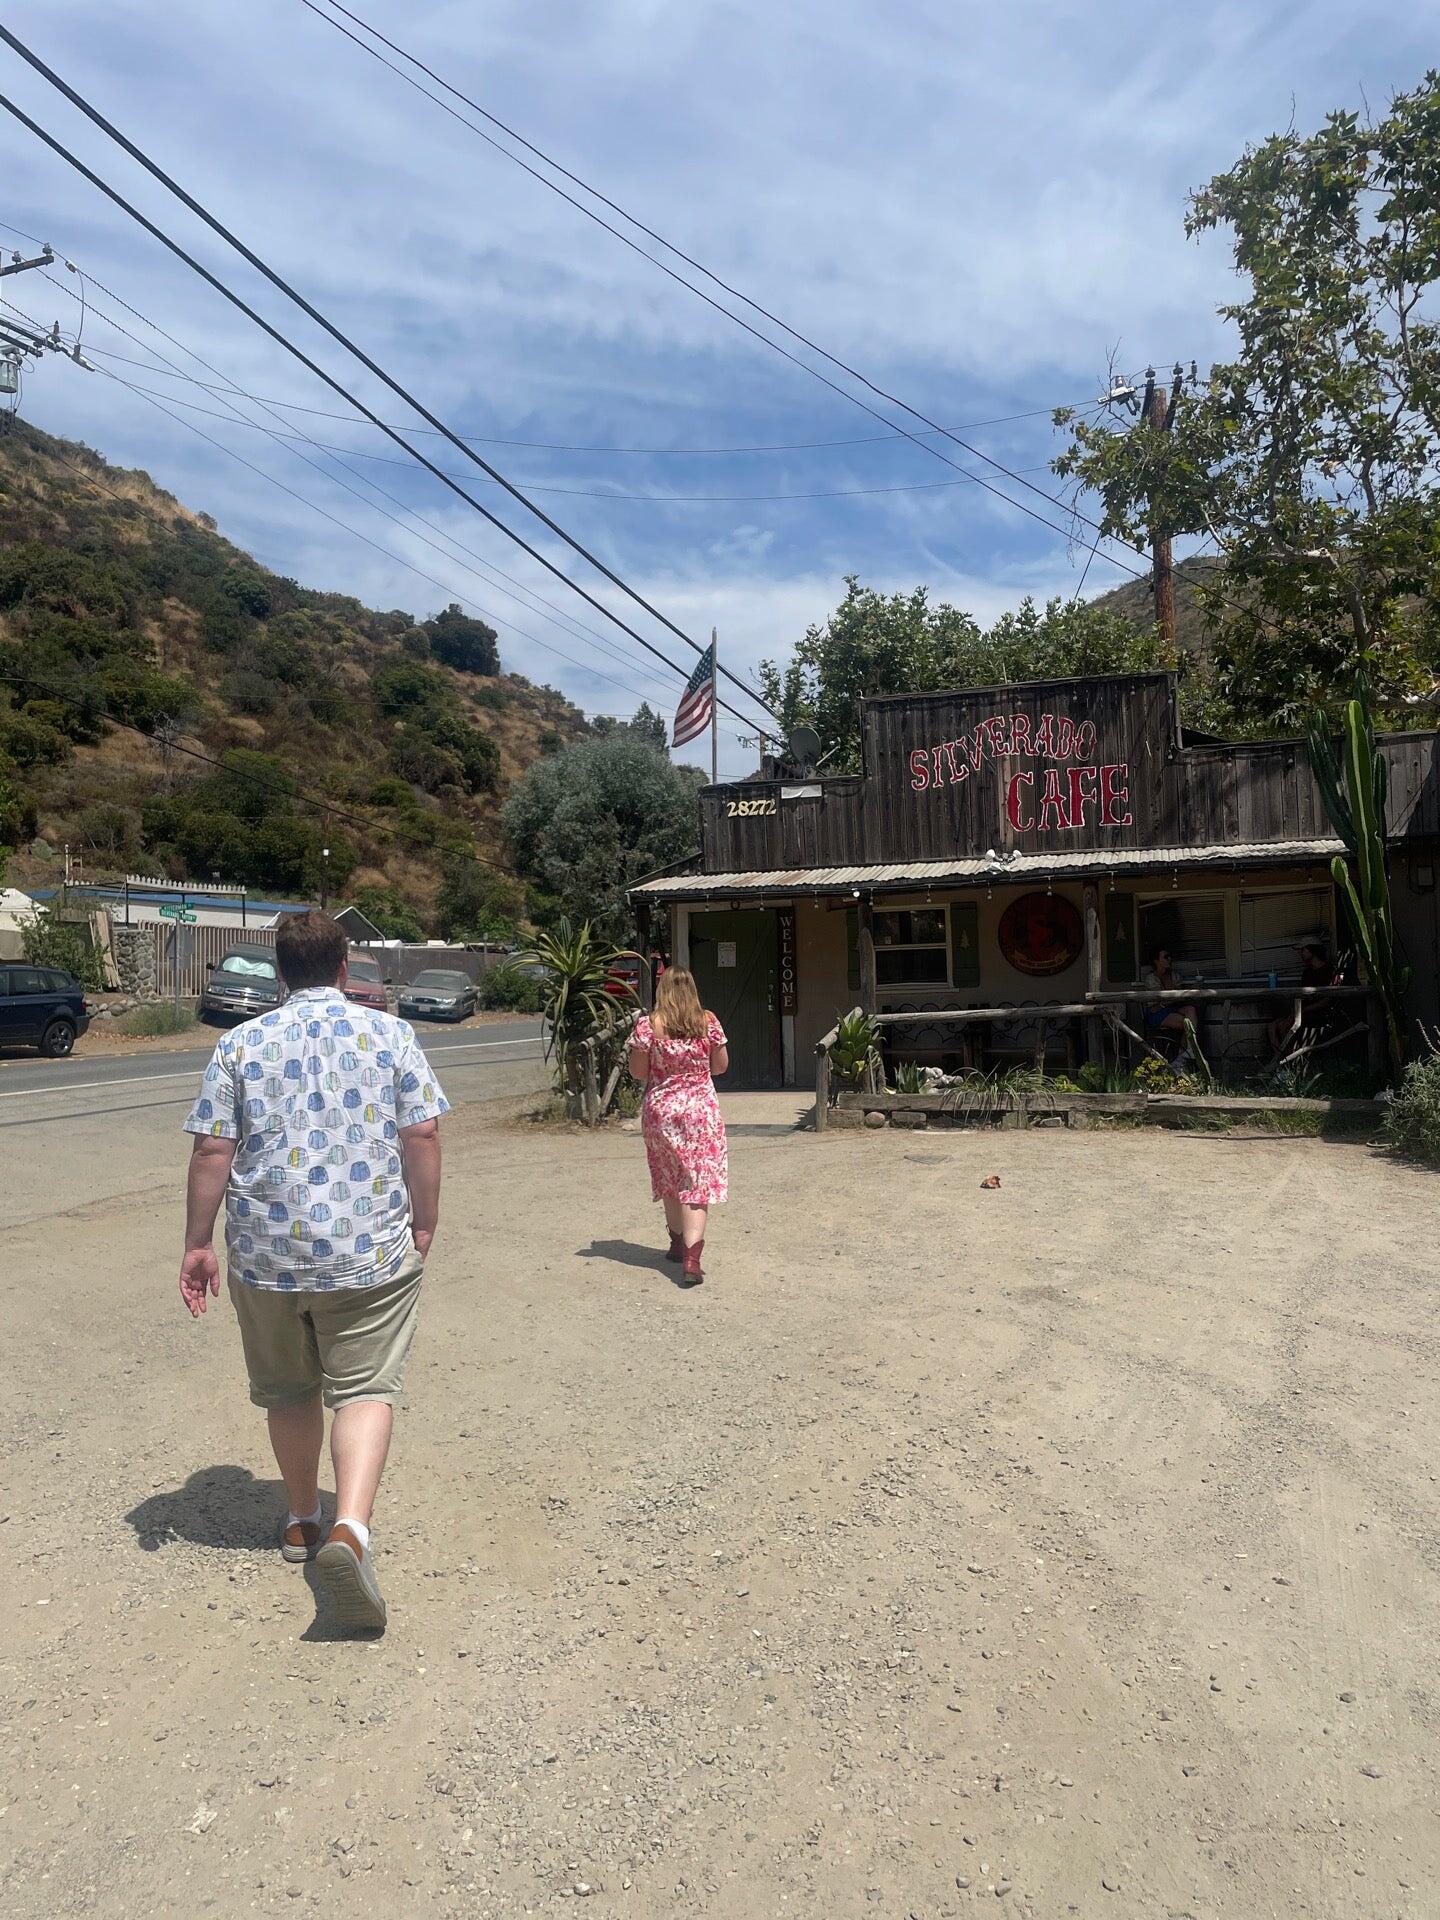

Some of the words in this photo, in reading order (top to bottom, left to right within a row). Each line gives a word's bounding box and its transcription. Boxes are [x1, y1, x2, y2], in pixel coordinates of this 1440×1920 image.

[910, 713, 1097, 791] SILVERADO
[726, 799, 777, 817] 28272
[1006, 764, 1133, 832] CAFE
[780, 916, 794, 1007] WELCOME
